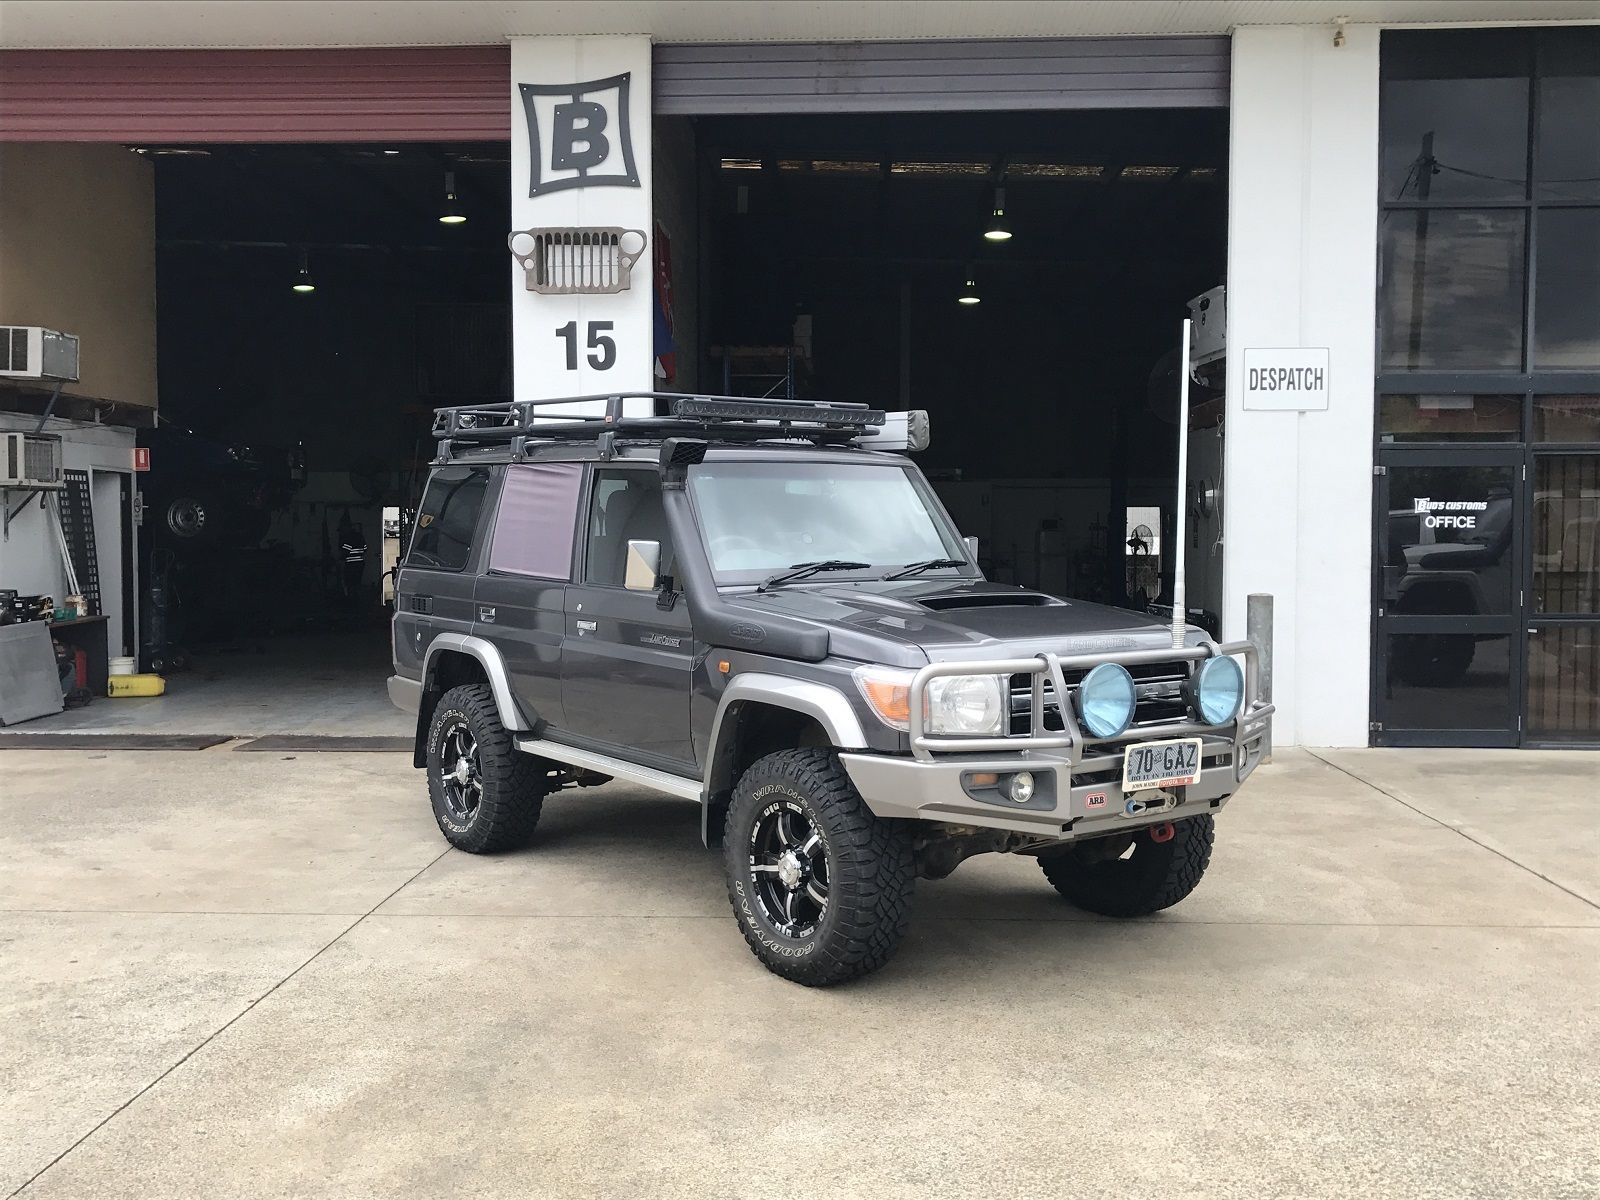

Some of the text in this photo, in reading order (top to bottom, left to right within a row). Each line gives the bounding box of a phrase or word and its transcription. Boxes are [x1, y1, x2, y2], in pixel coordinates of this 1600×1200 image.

[551, 101, 609, 172] B
[555, 320, 617, 371] 15
[1249, 367, 1324, 391] DESPATCH
[1425, 516, 1476, 528] OFFICE
[1135, 745, 1196, 774] 70 GAZ
[1089, 795, 1105, 805] ARB
[735, 880, 815, 957] GOODYEAR
